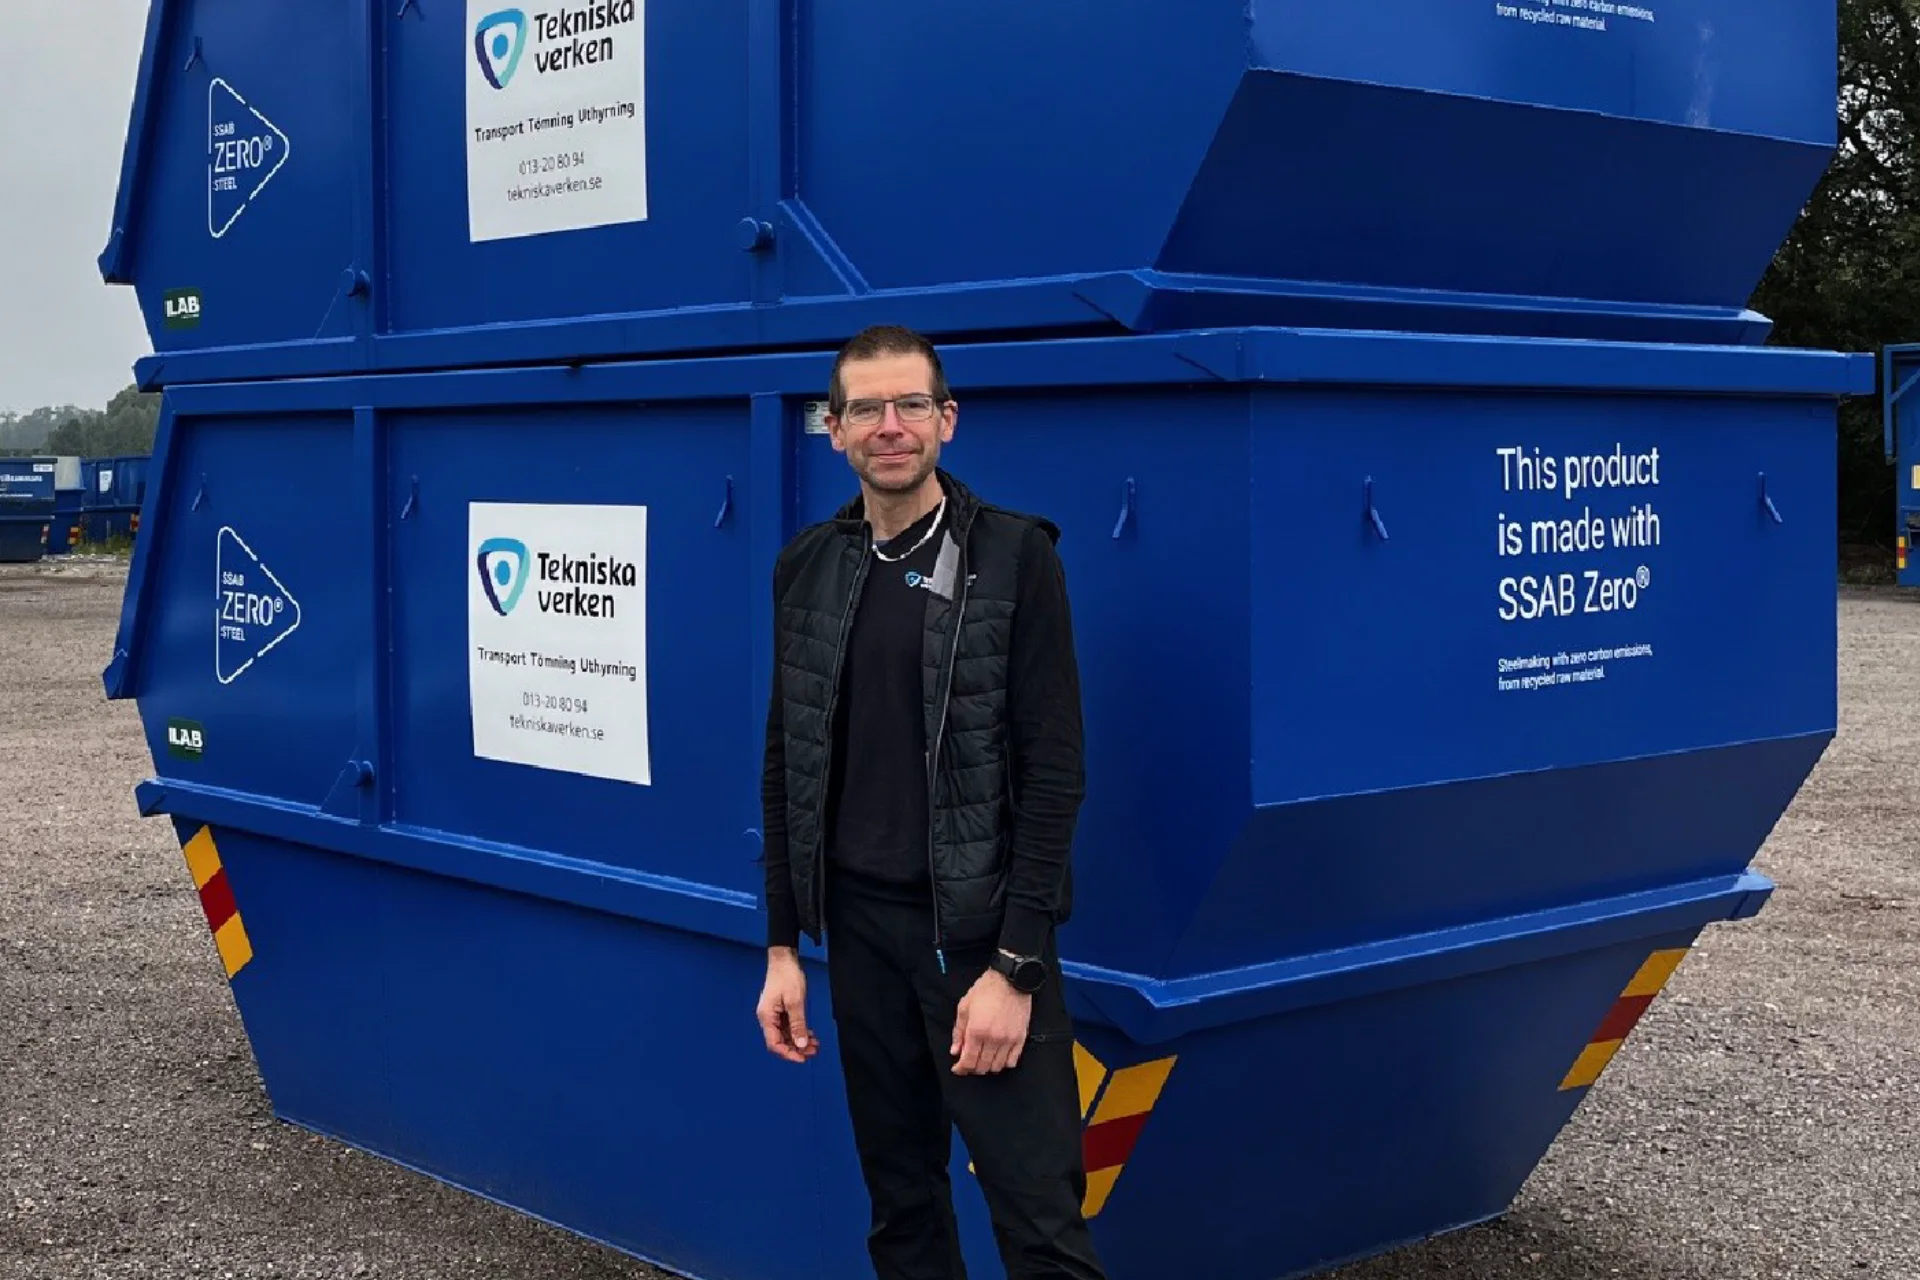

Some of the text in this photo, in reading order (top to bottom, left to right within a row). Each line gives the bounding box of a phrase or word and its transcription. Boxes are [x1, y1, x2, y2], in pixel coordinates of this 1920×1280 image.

[534, 0, 635, 43] Tekniska
[1496, 3, 1517, 17] from
[1519, 7, 1555, 24] recycled
[1555, 13, 1571, 25] raw
[534, 36, 613, 74] verken
[213, 121, 235, 136] SSAB
[475, 120, 525, 142] Transport
[578, 101, 635, 124] Uthyrning
[518, 151, 585, 176] 013-20 80 94
[213, 177, 238, 191] STEEL
[507, 175, 603, 202] tekniskaverken.se
[1496, 442, 1660, 499] This product
[1498, 503, 1660, 556] is made with
[222, 571, 245, 586] SSAB
[537, 552, 636, 587] Tekniska
[537, 586, 615, 618] verken
[1498, 573, 1575, 620] SSAB
[220, 625, 246, 641] STEEL
[477, 647, 527, 667] Transport
[580, 657, 637, 682] Uthyrning
[1498, 655, 1551, 673] Steelmaking
[1552, 651, 1570, 666] with
[1570, 650, 1587, 665] zero
[1587, 647, 1614, 662] carbon
[1498, 676, 1520, 691] from
[1521, 670, 1556, 690] recycled
[1556, 672, 1572, 684] raw
[522, 690, 588, 714] 013-20 80 94
[509, 714, 604, 741] tekniskaverken.se
